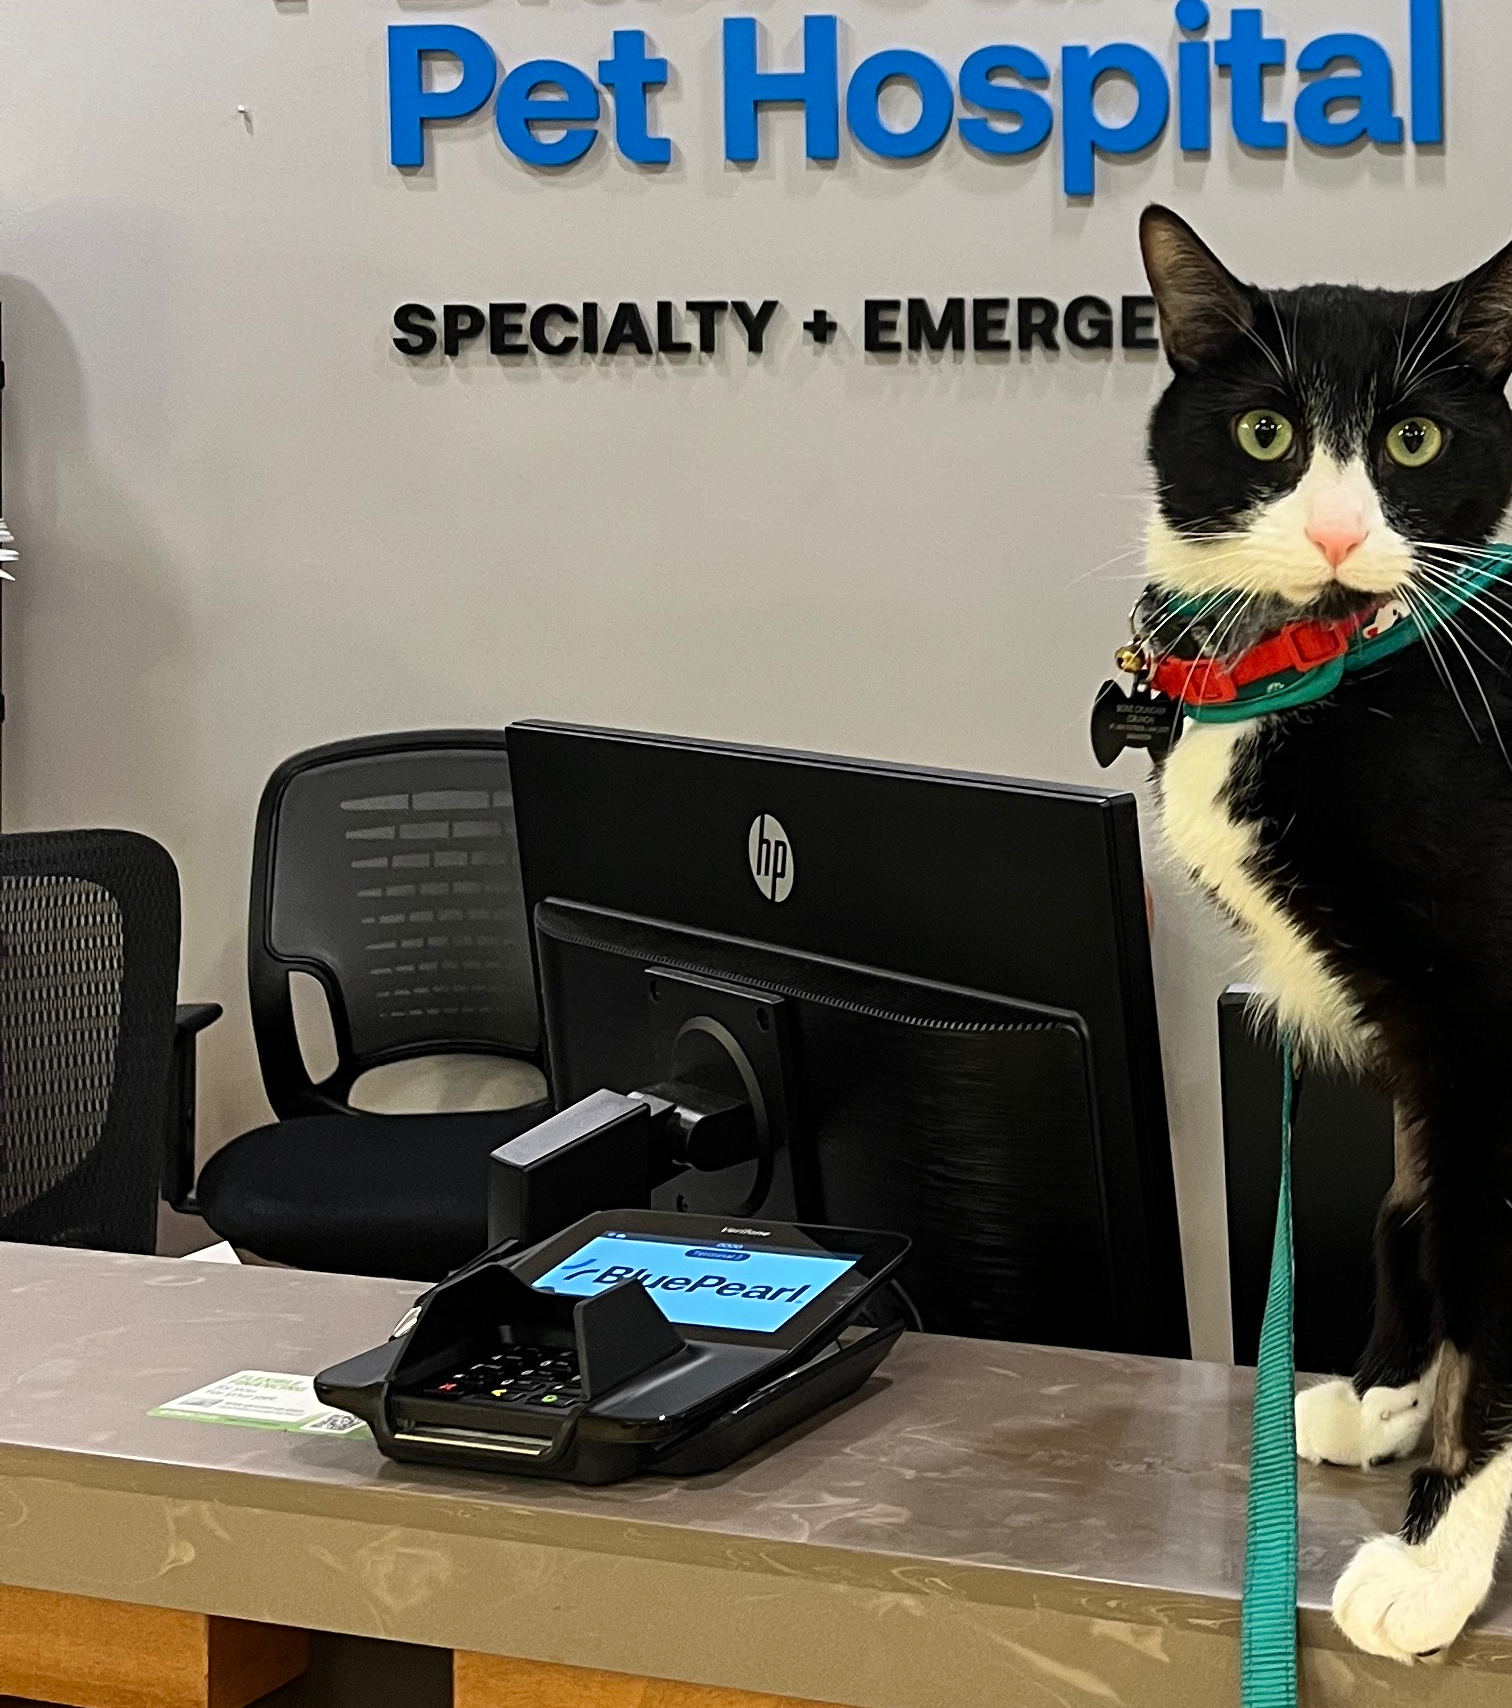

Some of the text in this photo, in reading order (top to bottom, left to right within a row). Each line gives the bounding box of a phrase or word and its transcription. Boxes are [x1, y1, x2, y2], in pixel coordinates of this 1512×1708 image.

[387, 0, 1445, 197] Pet Hospital
[393, 301, 778, 356] SPECIALTY
[803, 310, 837, 344] +
[756, 813, 787, 903] hp
[592, 1265, 812, 1303] BluePearl
